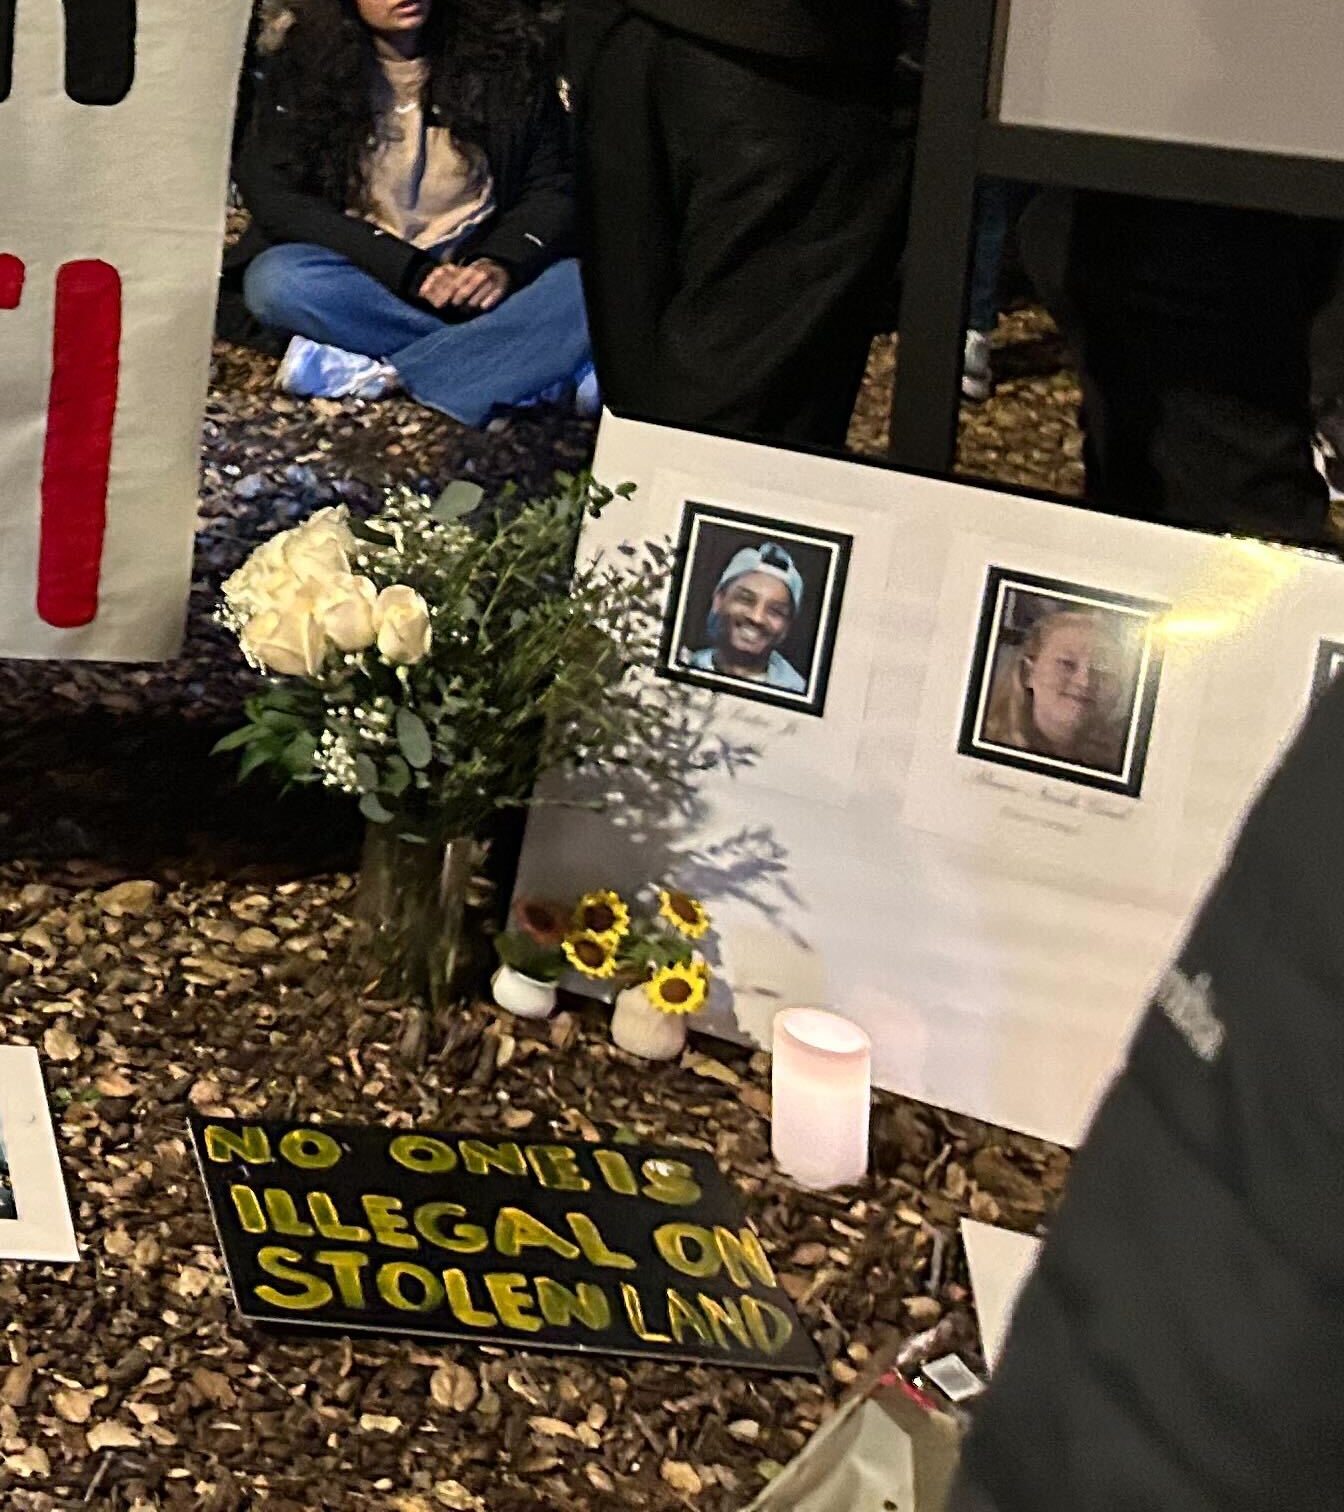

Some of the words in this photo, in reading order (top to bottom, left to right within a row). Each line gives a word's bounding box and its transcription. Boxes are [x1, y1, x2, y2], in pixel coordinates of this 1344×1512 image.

[204, 1124, 343, 1169] NO
[389, 1135, 591, 1191] ONE
[593, 1149, 703, 1206] IS
[231, 1184, 637, 1270] ILLEGAL
[652, 1221, 778, 1289] ON
[254, 1245, 612, 1332] STOLEN
[620, 1281, 795, 1355] LAND
